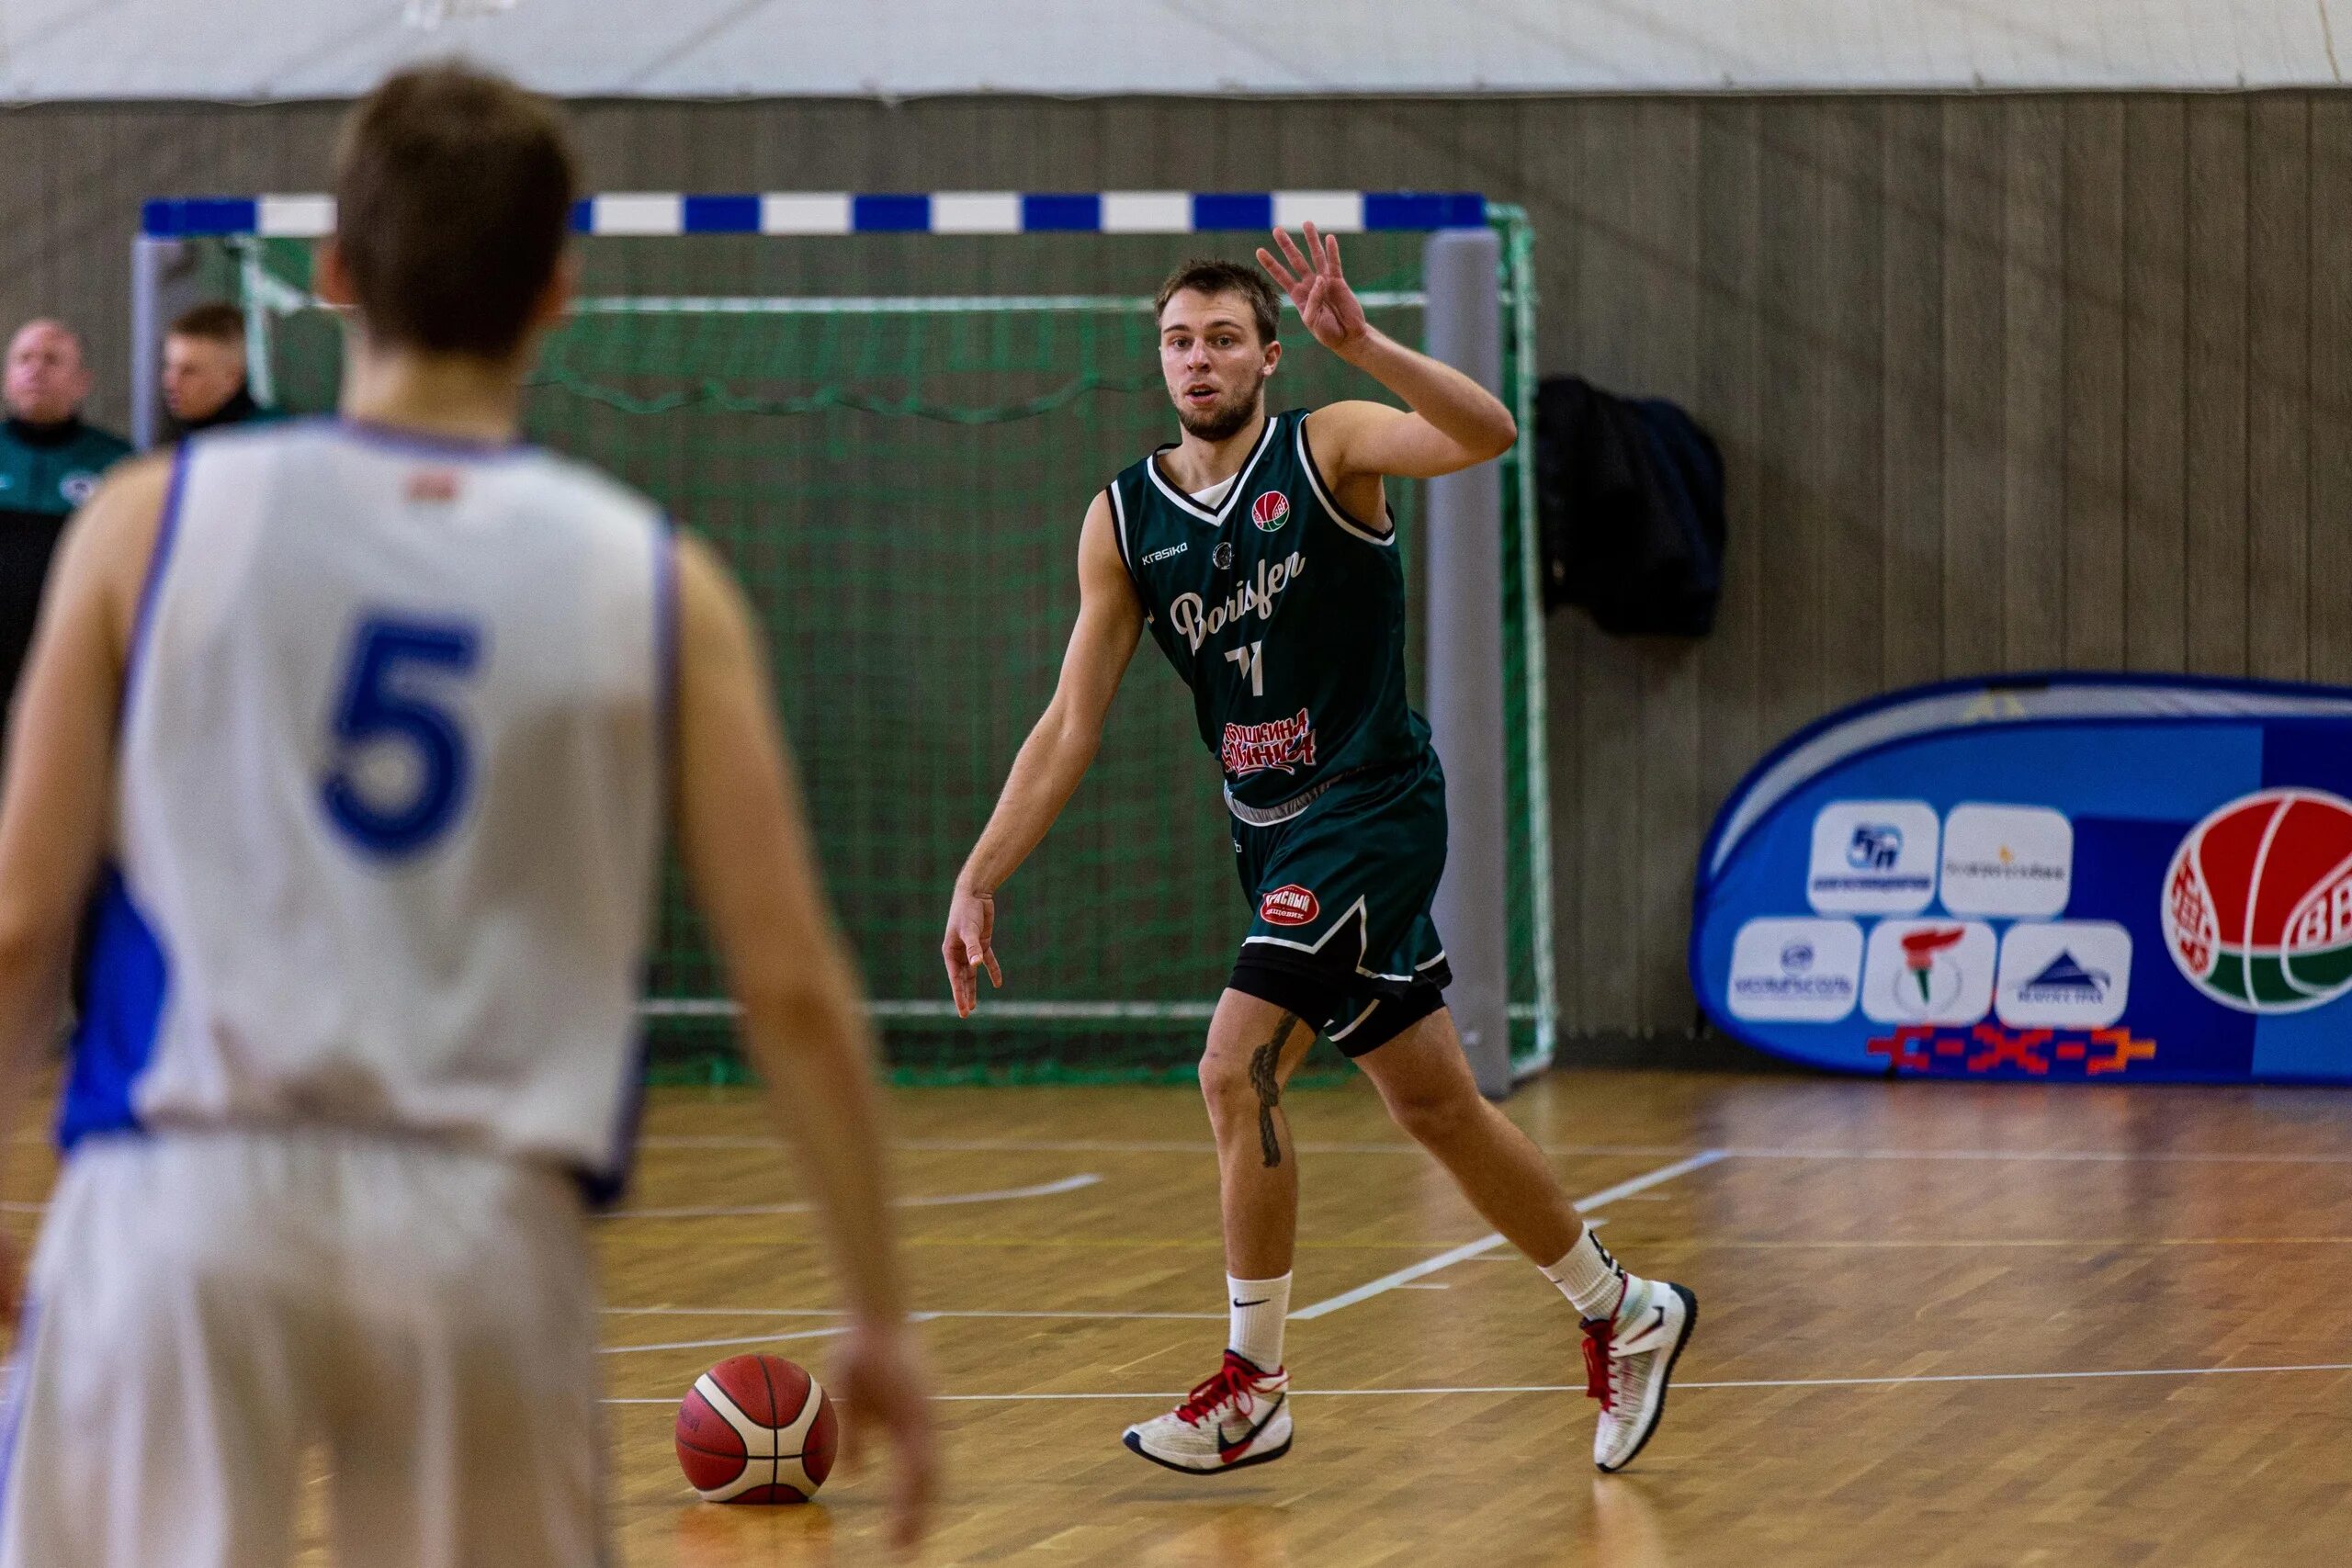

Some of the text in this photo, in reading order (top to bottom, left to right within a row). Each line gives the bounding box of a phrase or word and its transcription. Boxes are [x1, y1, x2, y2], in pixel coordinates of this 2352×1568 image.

[1141, 542, 1189, 566] krasiko
[1170, 551, 1306, 657] Borisfen
[323, 615, 485, 852] 5
